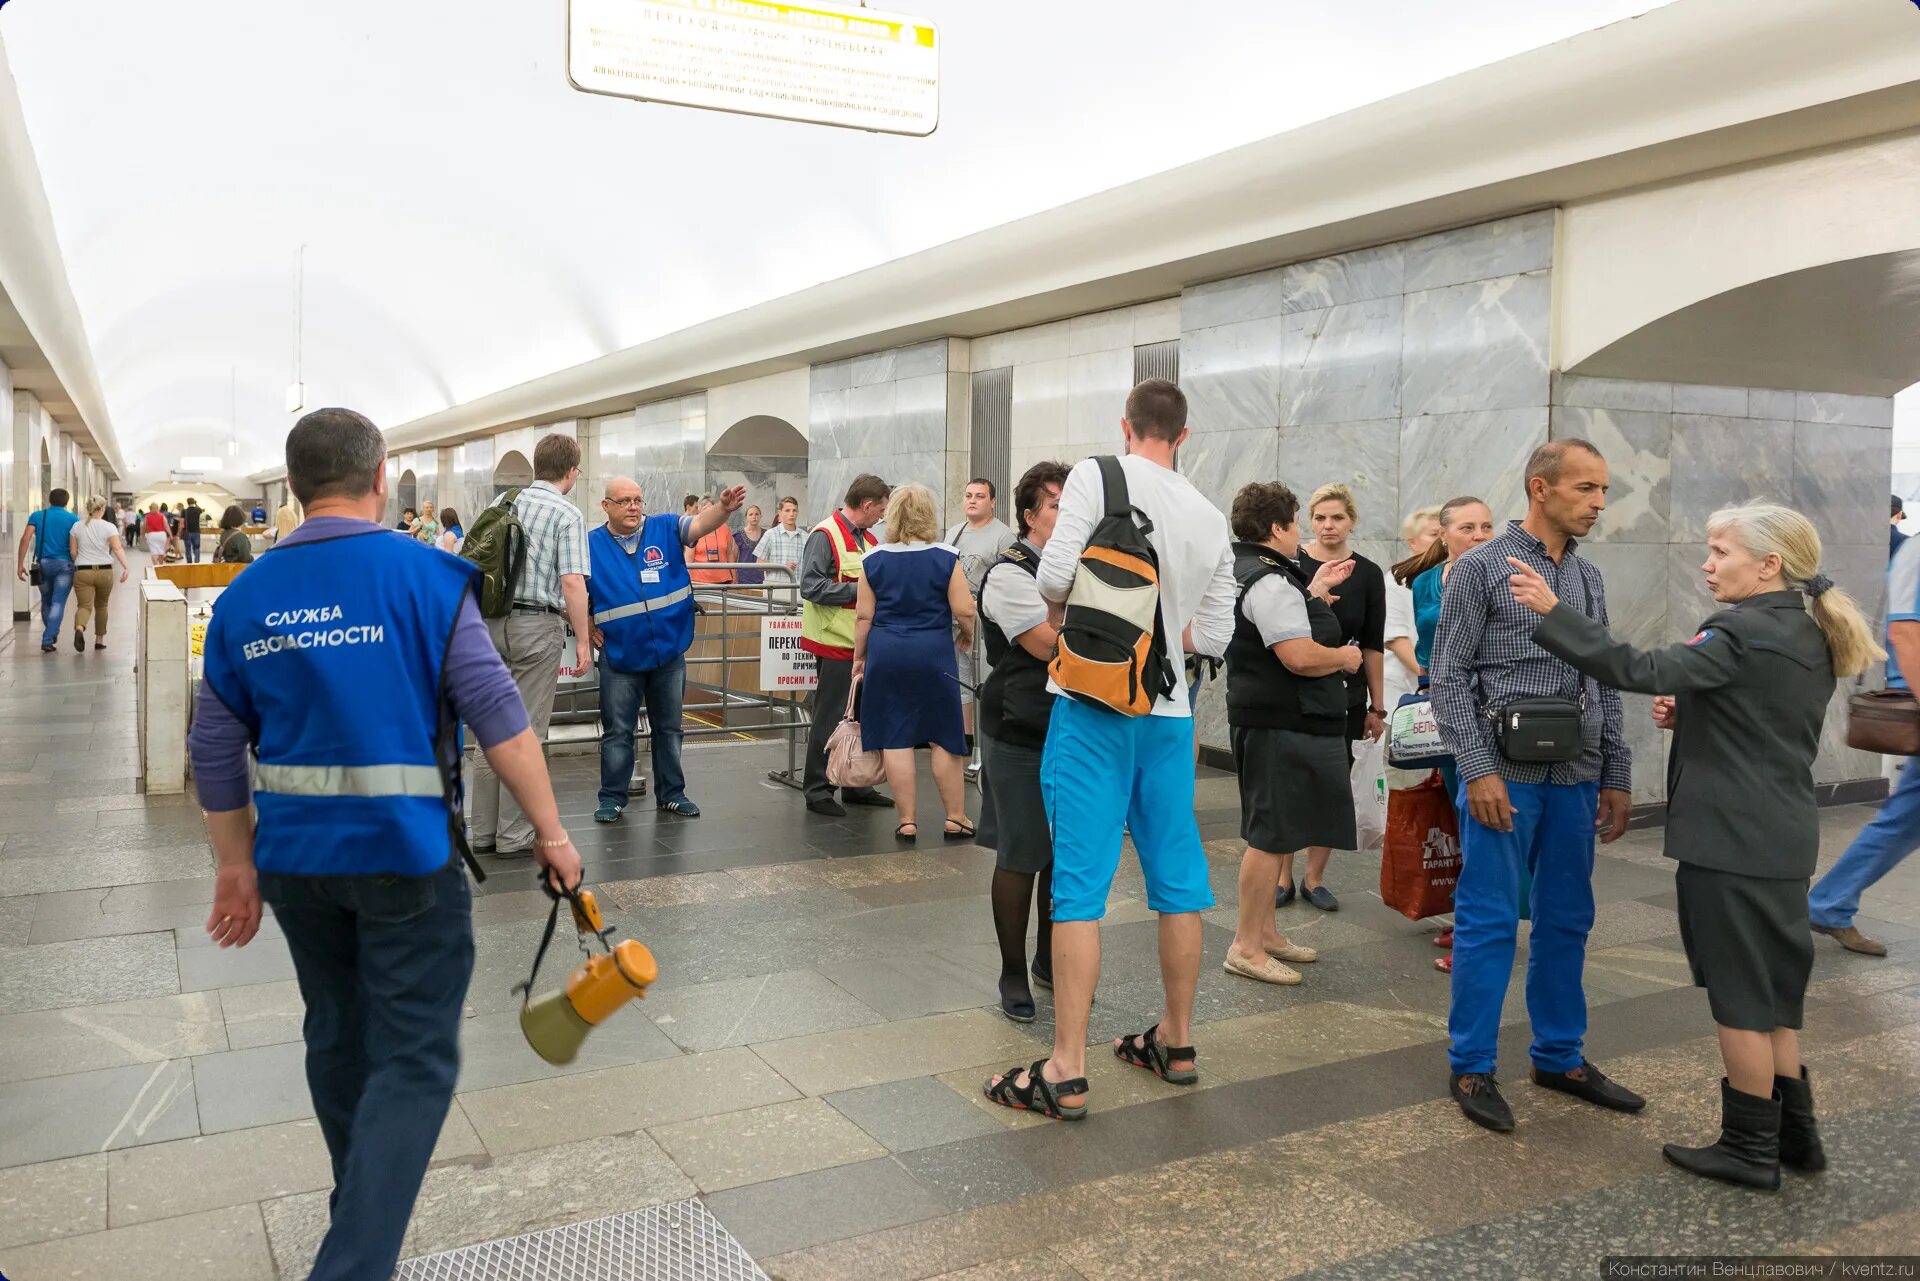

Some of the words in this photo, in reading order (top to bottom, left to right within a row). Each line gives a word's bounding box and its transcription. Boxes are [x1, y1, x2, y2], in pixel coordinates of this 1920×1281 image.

[265, 605, 343, 627] СЛУЖБА
[243, 625, 384, 661] БЕЗОПАСНОСТИ
[782, 652, 790, 660] ПО
[777, 676, 804, 685] ПРОСИМ
